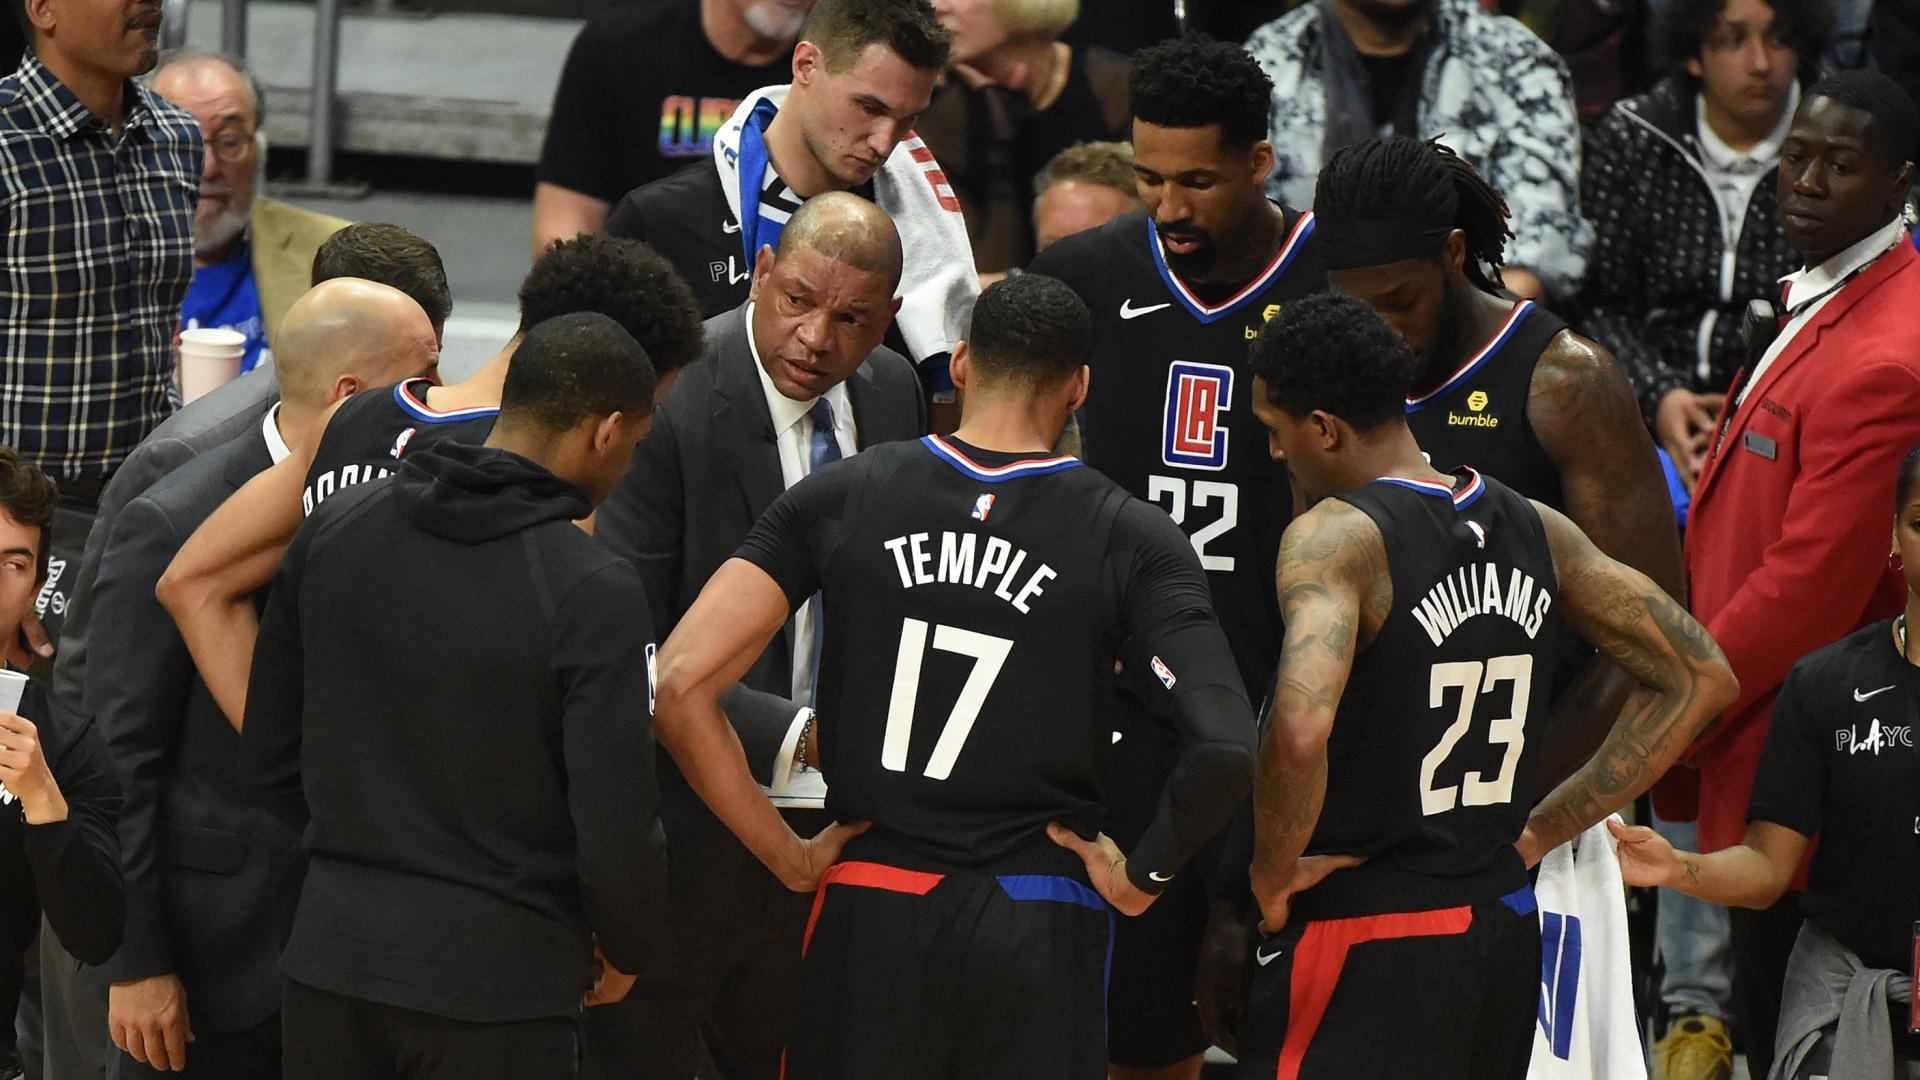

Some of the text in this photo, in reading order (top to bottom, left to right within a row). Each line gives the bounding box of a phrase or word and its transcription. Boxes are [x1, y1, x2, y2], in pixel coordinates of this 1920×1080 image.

[1448, 411, 1498, 427] bumble
[883, 531, 1058, 615] TEMPLE
[1411, 562, 1552, 647] WILLIAMS
[881, 617, 1015, 781] 17
[1419, 654, 1533, 816] 23
